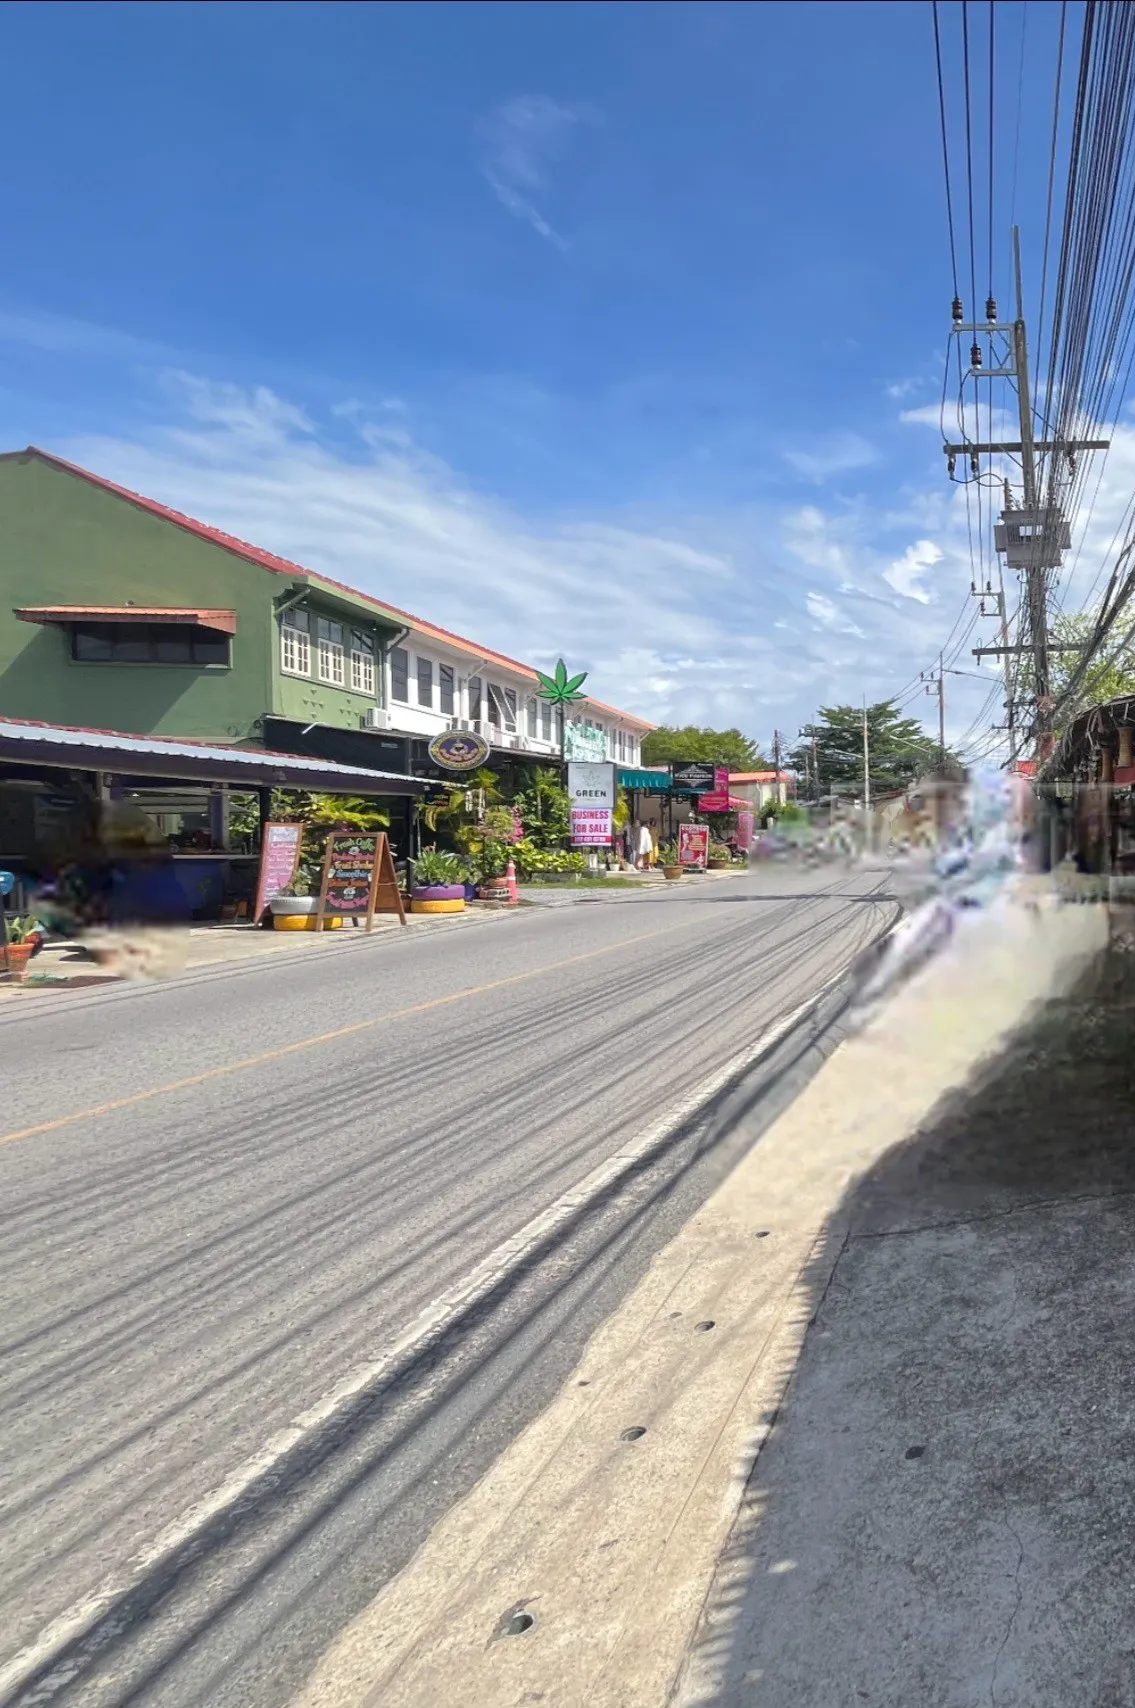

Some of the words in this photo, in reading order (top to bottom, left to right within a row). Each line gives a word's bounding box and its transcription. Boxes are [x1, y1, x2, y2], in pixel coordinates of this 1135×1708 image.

[576, 790, 606, 798] GREEN
[572, 811, 609, 819] BUSINESS
[573, 824, 587, 833] FOR
[588, 824, 608, 832] SALE
